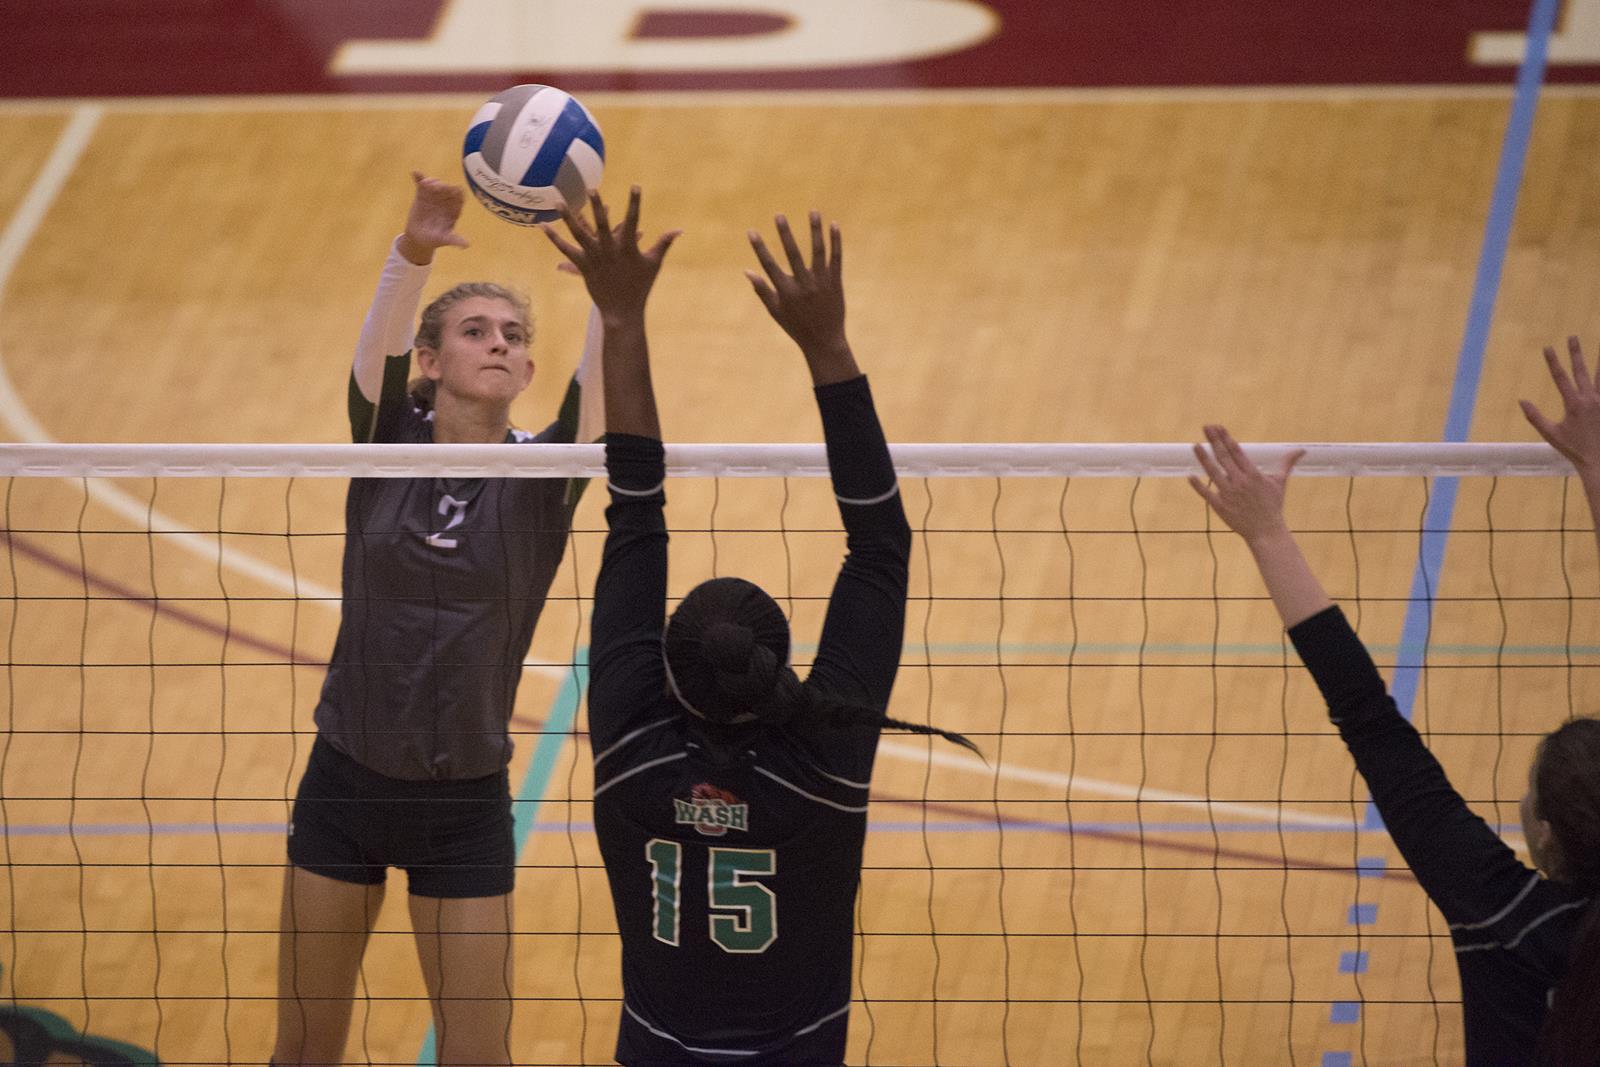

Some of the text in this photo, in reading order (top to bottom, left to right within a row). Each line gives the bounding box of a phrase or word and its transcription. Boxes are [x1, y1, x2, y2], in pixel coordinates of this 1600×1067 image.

[425, 494, 469, 548] 2
[674, 799, 748, 831] WASH
[645, 838, 778, 953] 15
